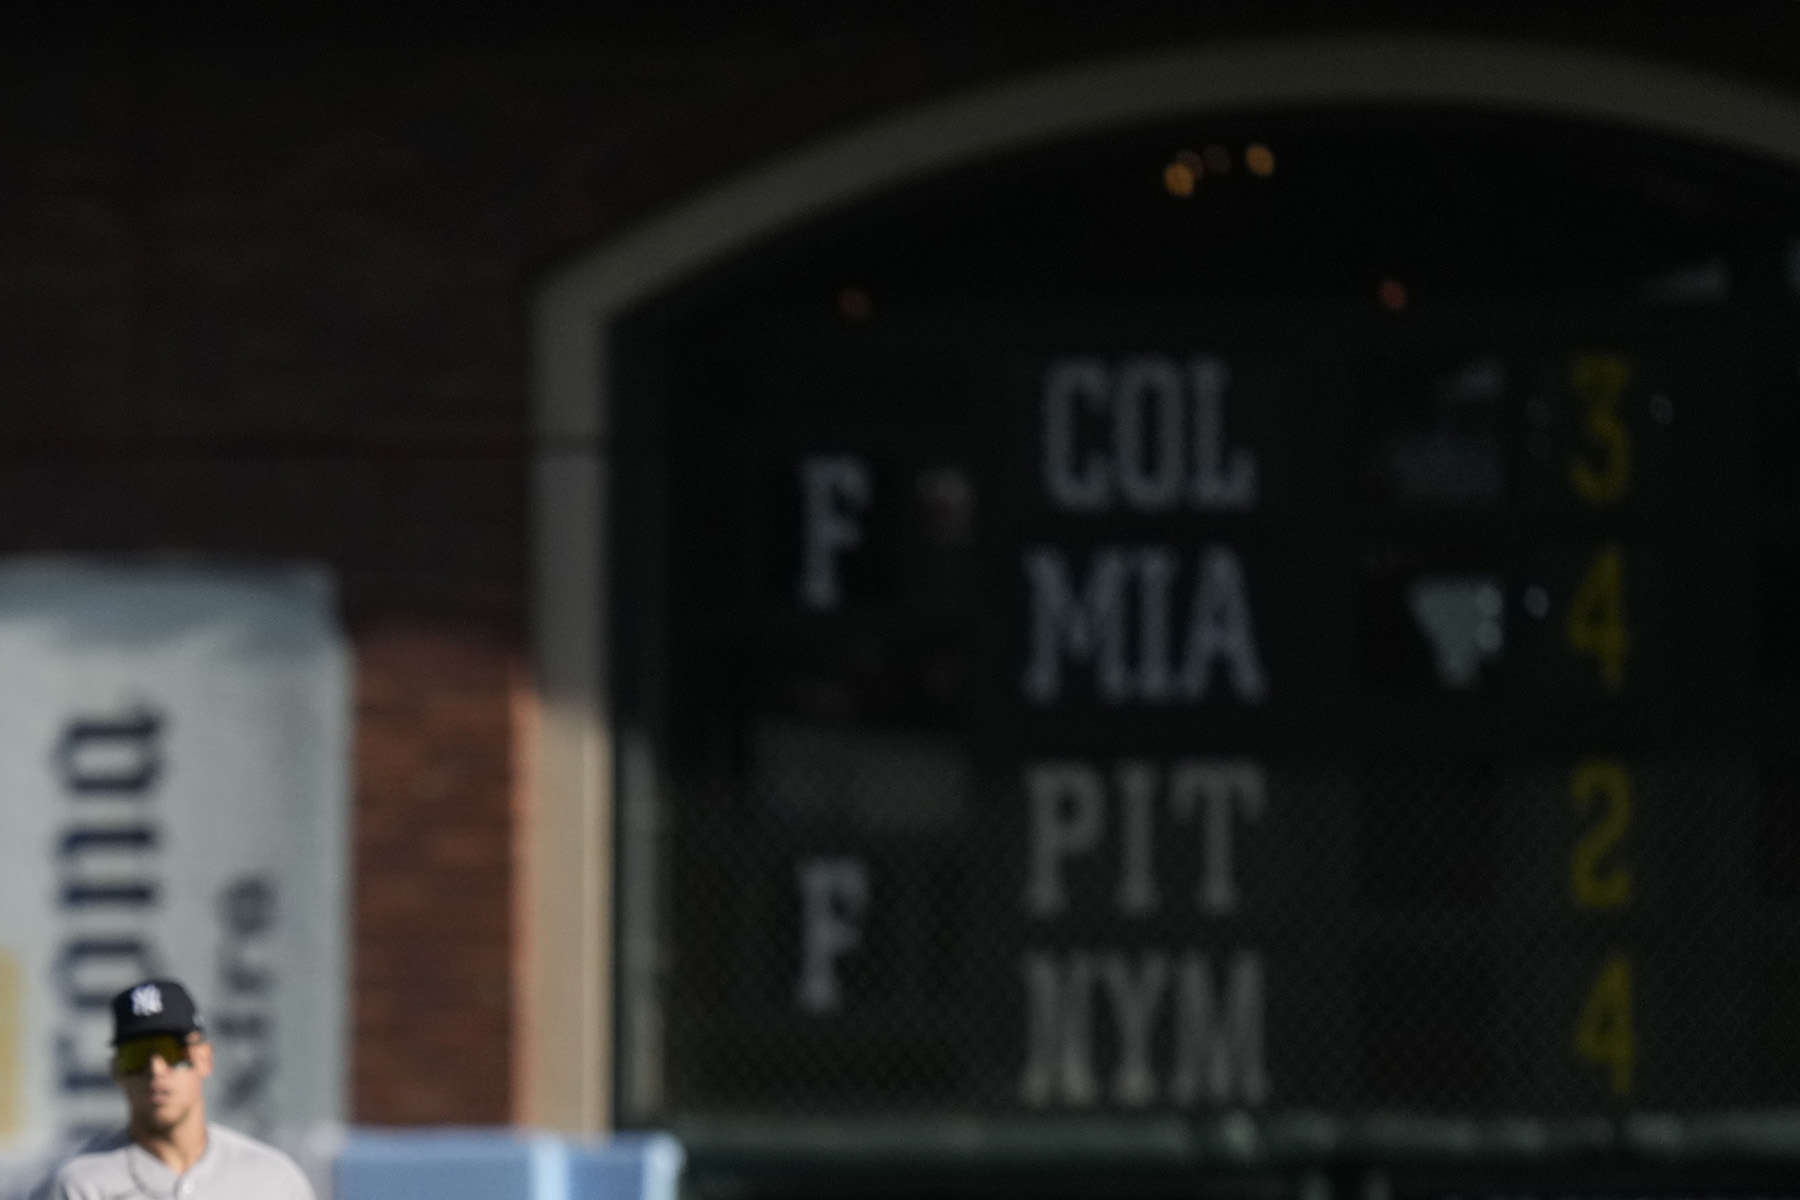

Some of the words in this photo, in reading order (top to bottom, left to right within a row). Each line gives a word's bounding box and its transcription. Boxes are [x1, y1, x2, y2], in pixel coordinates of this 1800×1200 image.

[1042, 357, 1258, 513] COL
[1568, 352, 1633, 506] 3
[800, 454, 871, 611] F
[1022, 546, 1267, 704] MIA
[1566, 546, 1631, 688] 4
[1022, 762, 1267, 918] PIT
[1569, 759, 1634, 911] 2
[798, 857, 869, 1014] F
[1018, 953, 1269, 1110] NYM
[1573, 952, 1638, 1098] 4
